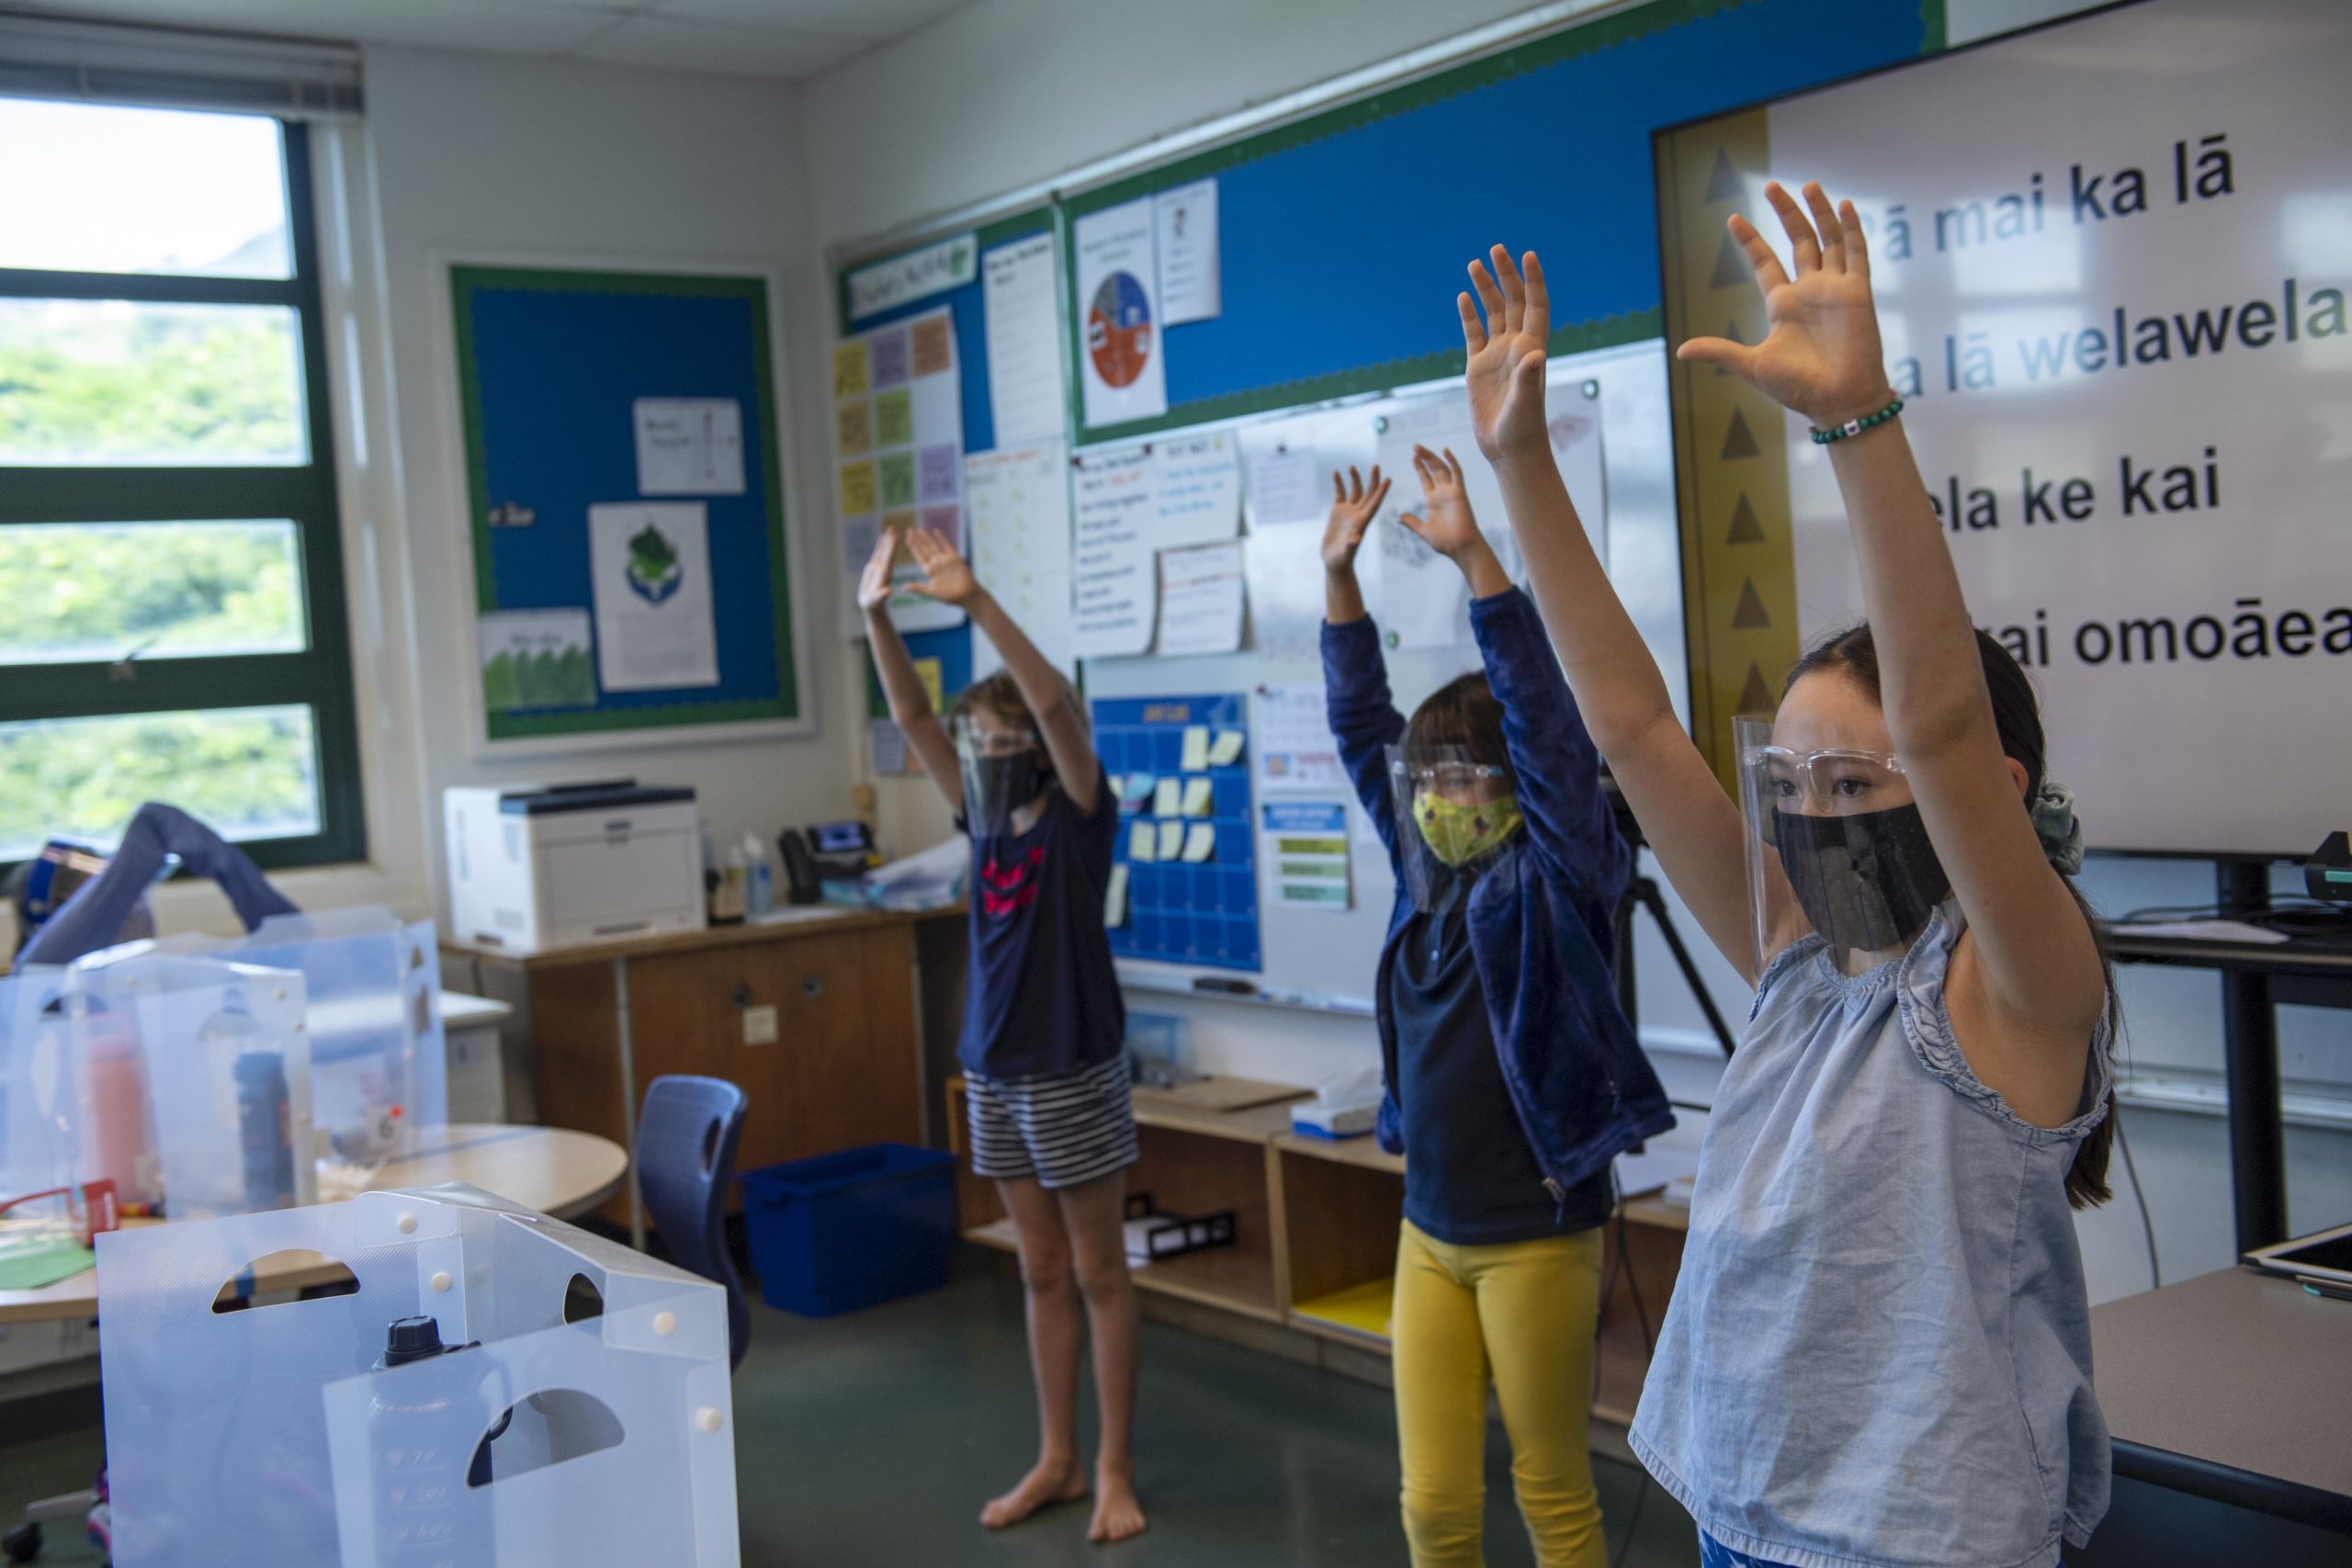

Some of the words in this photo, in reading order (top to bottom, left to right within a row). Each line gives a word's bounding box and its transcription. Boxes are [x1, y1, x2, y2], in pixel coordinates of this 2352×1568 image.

[1935, 173, 2044, 252] mai
[2071, 164, 2148, 223] ka
[2175, 132, 2235, 204] lā
[1894, 355, 1922, 400] a
[1945, 332, 1995, 392] lā
[2018, 277, 2347, 379] welawela
[1929, 474, 1999, 533] la
[2022, 468, 2095, 525] ke
[2120, 446, 2220, 516] kai
[1977, 608, 2050, 668] ai
[2075, 597, 2352, 665] omoāea
